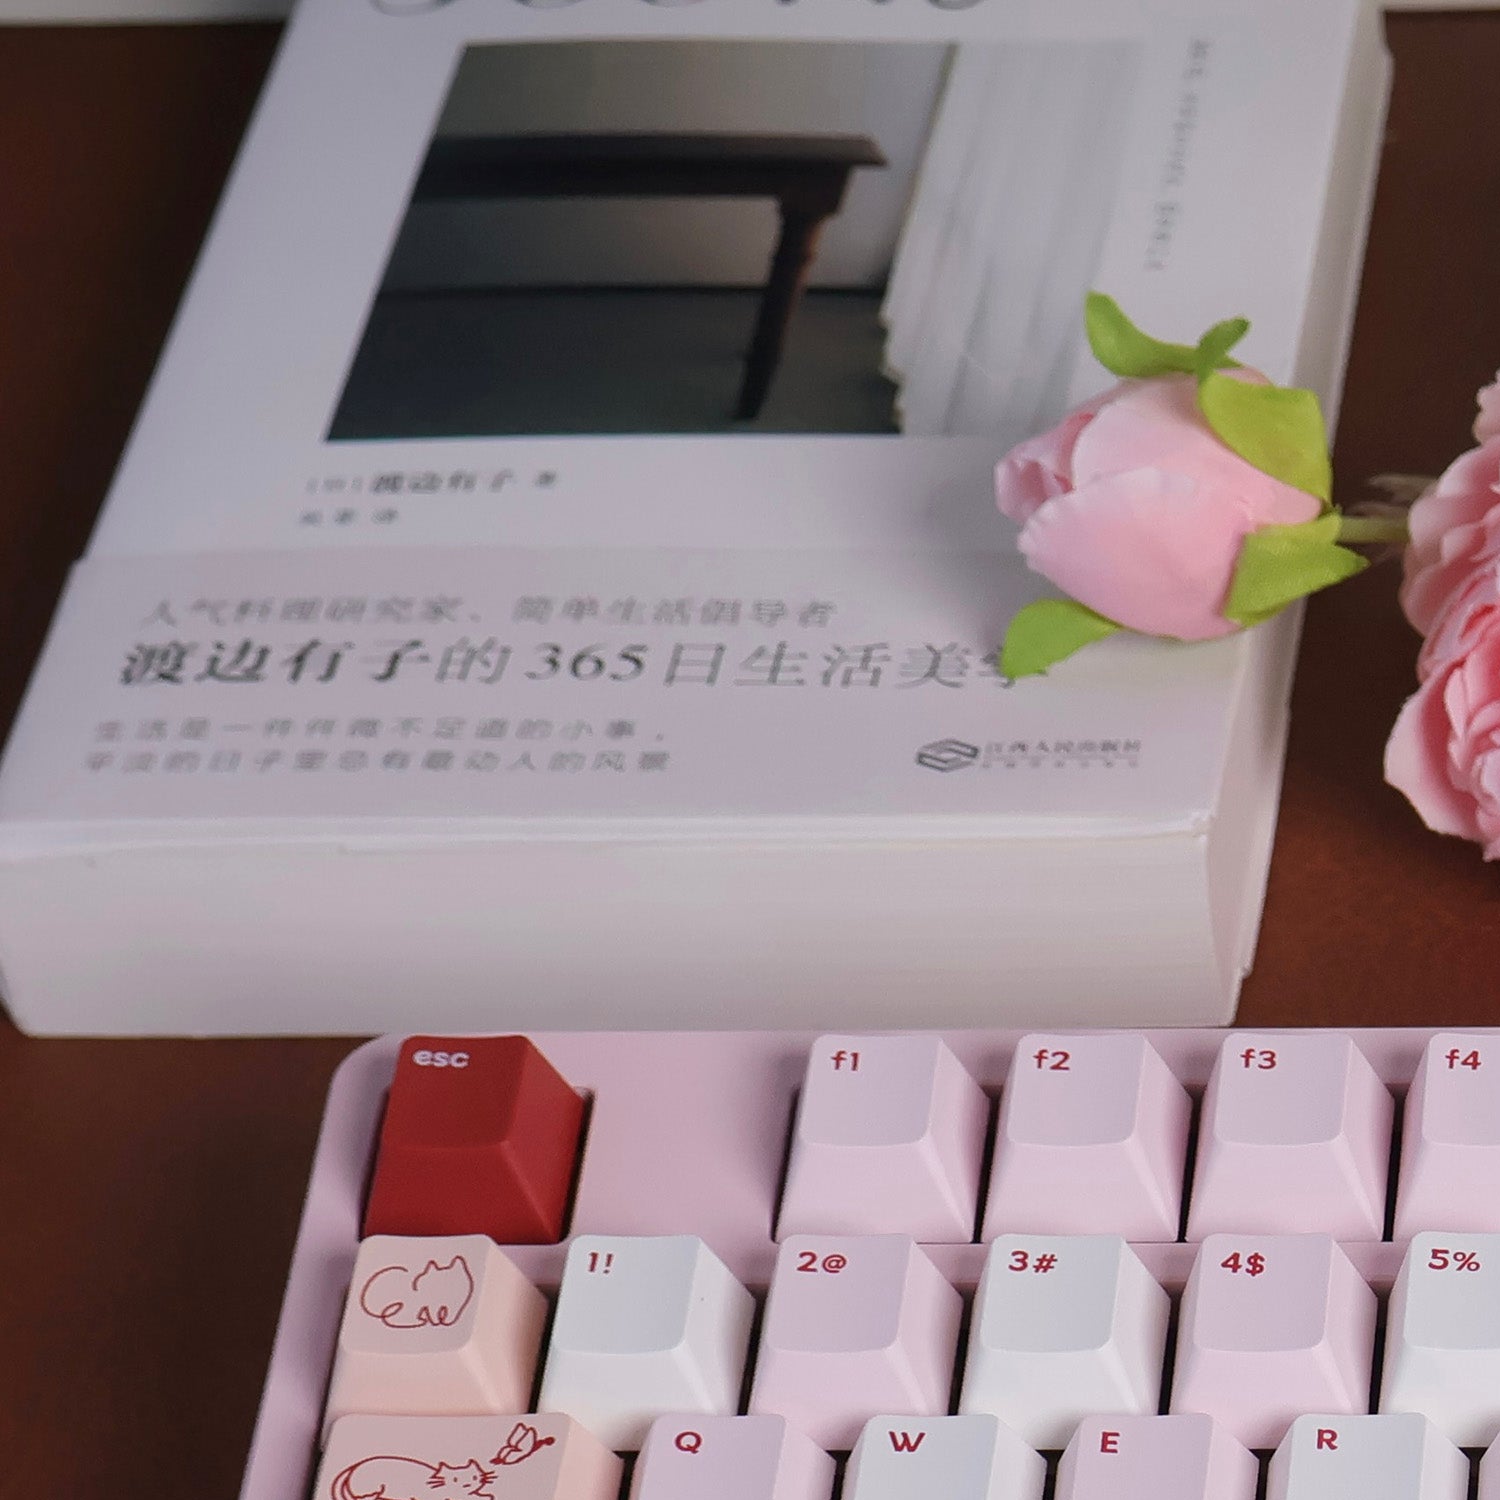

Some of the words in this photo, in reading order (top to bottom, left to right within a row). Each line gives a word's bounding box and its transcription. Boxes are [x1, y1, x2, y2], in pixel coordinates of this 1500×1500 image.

[412, 1049, 470, 1069] esc
[830, 1049, 860, 1073] f1
[1032, 1048, 1071, 1072] f2
[1239, 1047, 1278, 1071] f3
[1444, 1047, 1483, 1072] f4
[588, 1251, 614, 1275] 1!
[795, 1250, 848, 1275] 2@
[1007, 1249, 1059, 1274] 3#
[1219, 1251, 1266, 1278] 4$
[1427, 1247, 1482, 1273] 5%
[673, 1430, 703, 1456] Q
[887, 1430, 927, 1454] W
[1099, 1430, 1122, 1455] E
[1315, 1427, 1339, 1452] R
